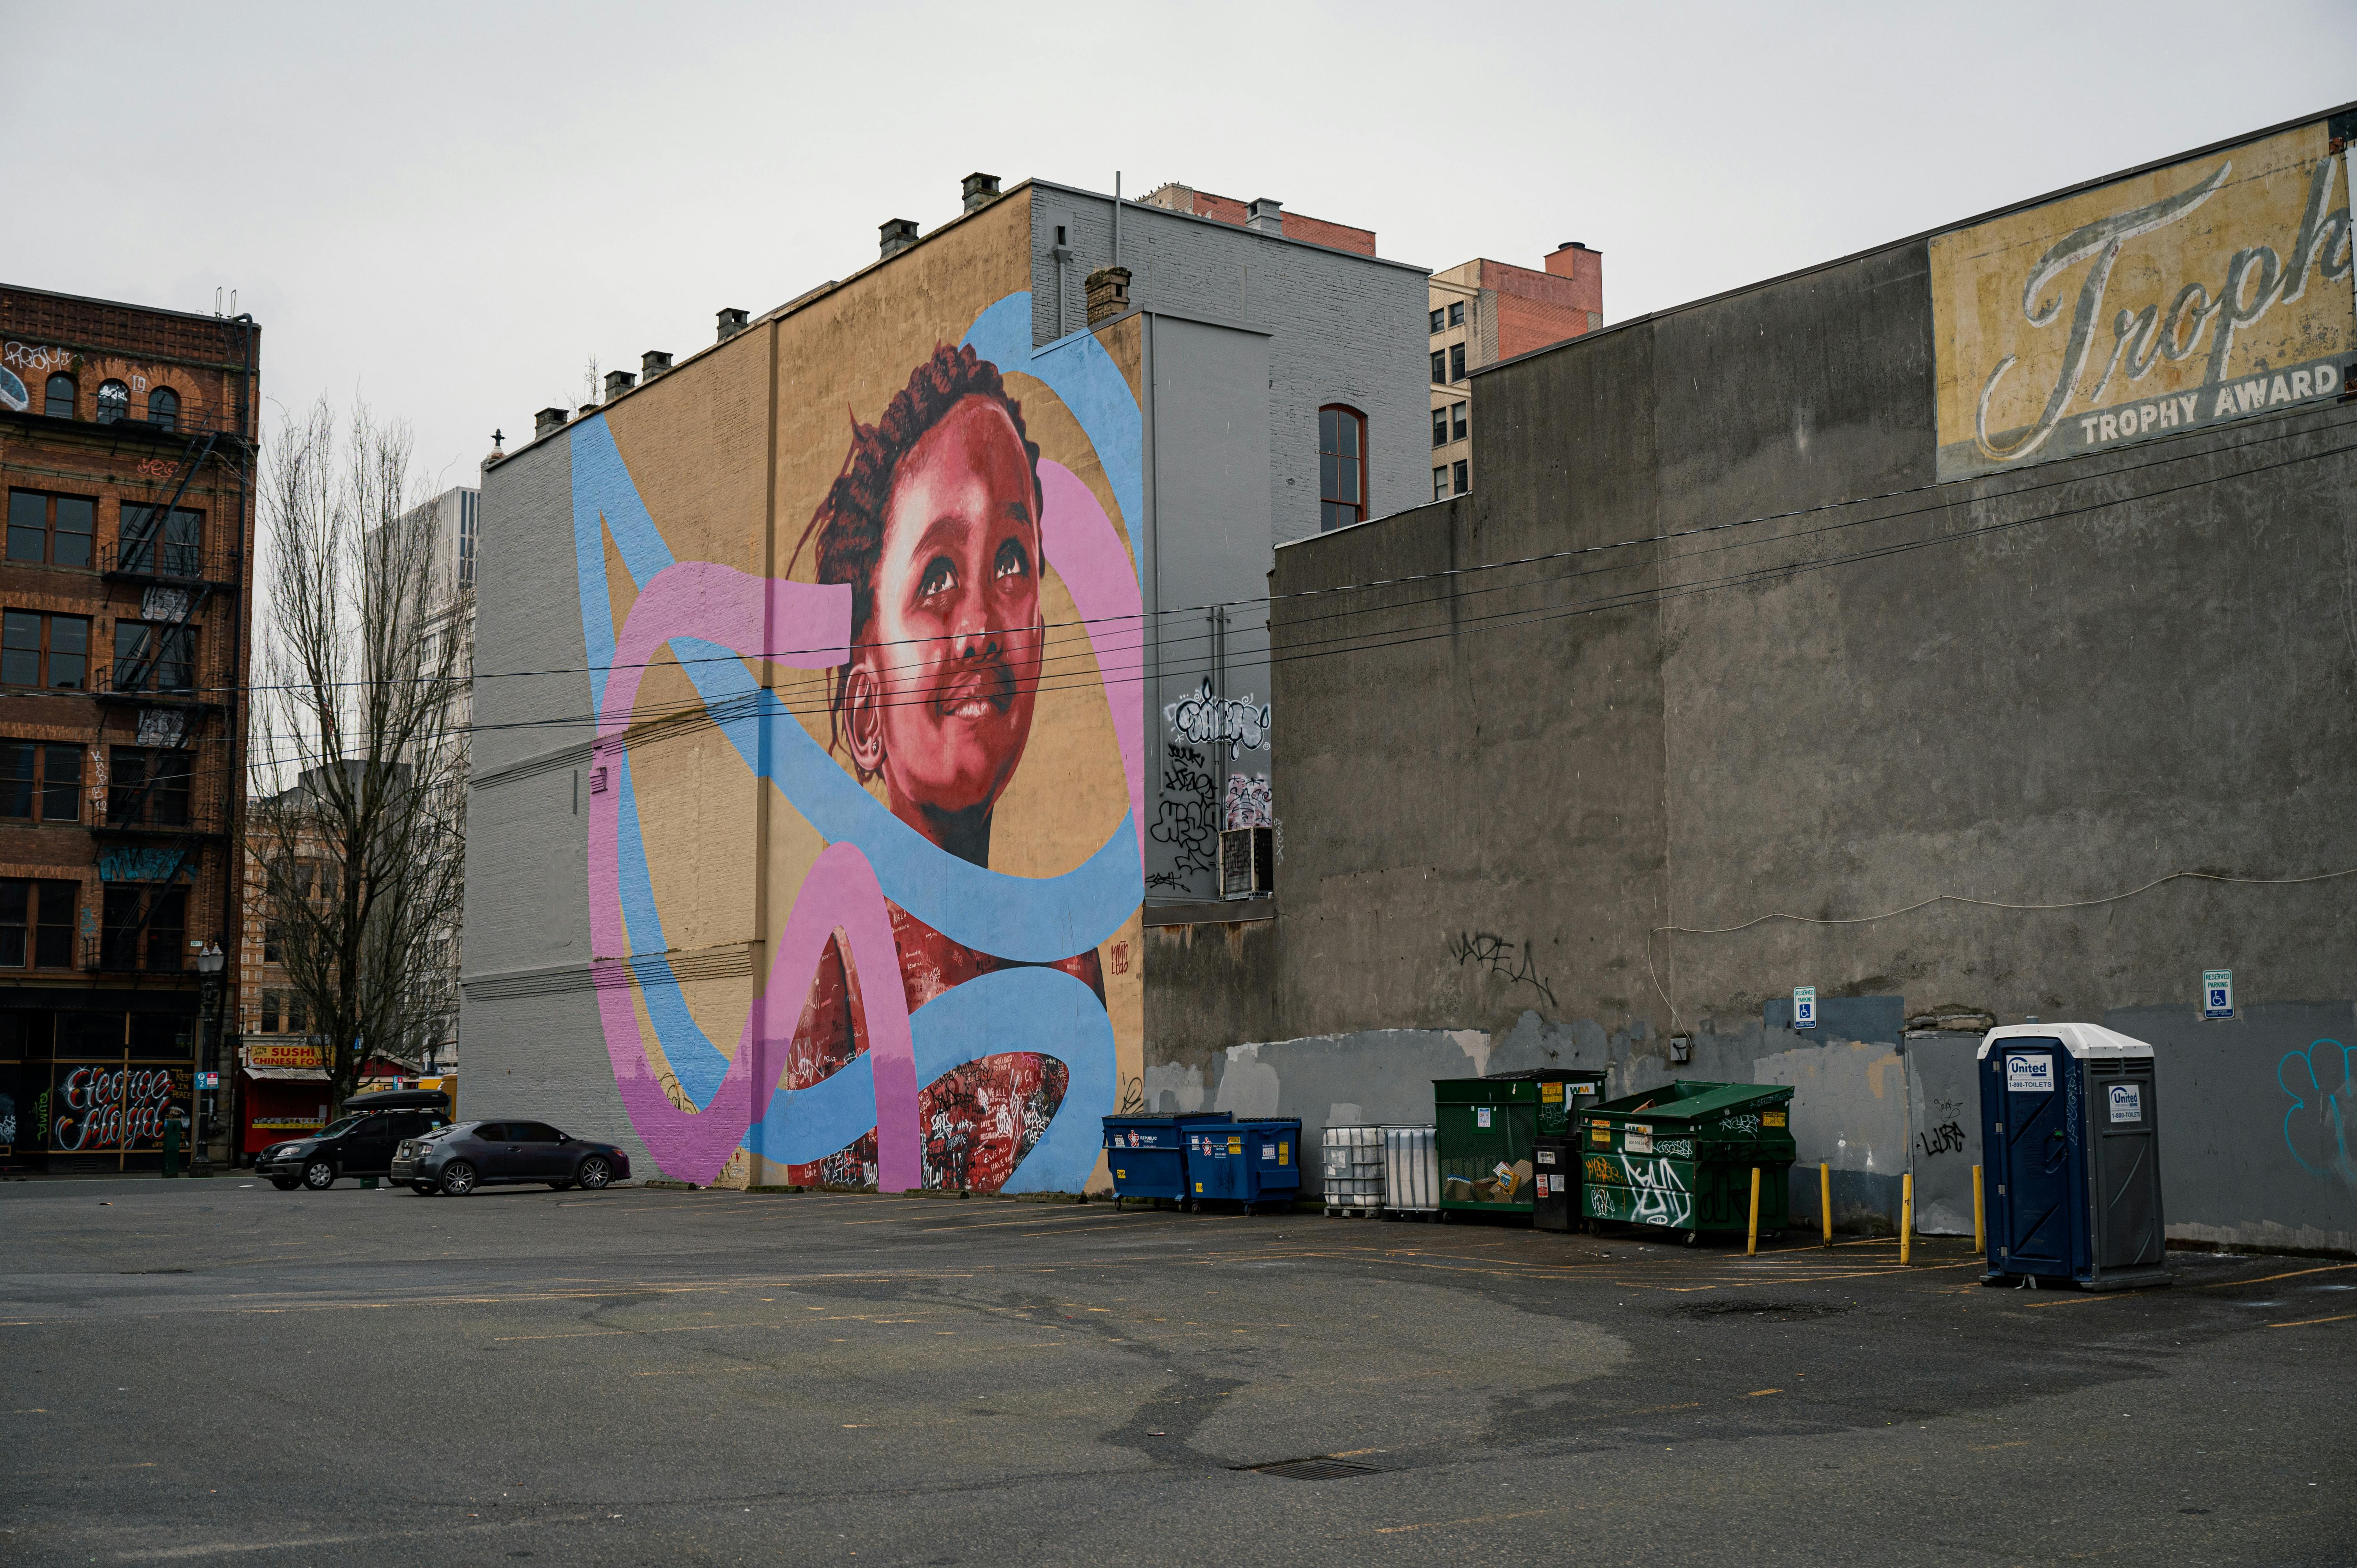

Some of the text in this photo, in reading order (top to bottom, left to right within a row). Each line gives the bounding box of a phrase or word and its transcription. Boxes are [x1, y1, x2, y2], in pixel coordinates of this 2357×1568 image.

[2081, 365, 2338, 444] TROPHY AWARD
[271, 1047, 315, 1057] SUSHI
[253, 1057, 297, 1065] CHINESE
[2011, 1062, 2047, 1073] United
[58, 1067, 175, 1111] George
[171, 1089, 193, 1100] PEACE
[996, 1088, 1006, 1097] ALL
[1569, 1086, 1590, 1095] WM
[2114, 1093, 2138, 1104] United
[988, 1104, 1000, 1114] SAME
[55, 1097, 171, 1150] Floyd
[981, 1119, 991, 1128] LOVE
[989, 1144, 1009, 1160] WE ALL
[991, 1158, 1005, 1172] HAVE
[993, 1169, 1008, 1185] HEART
